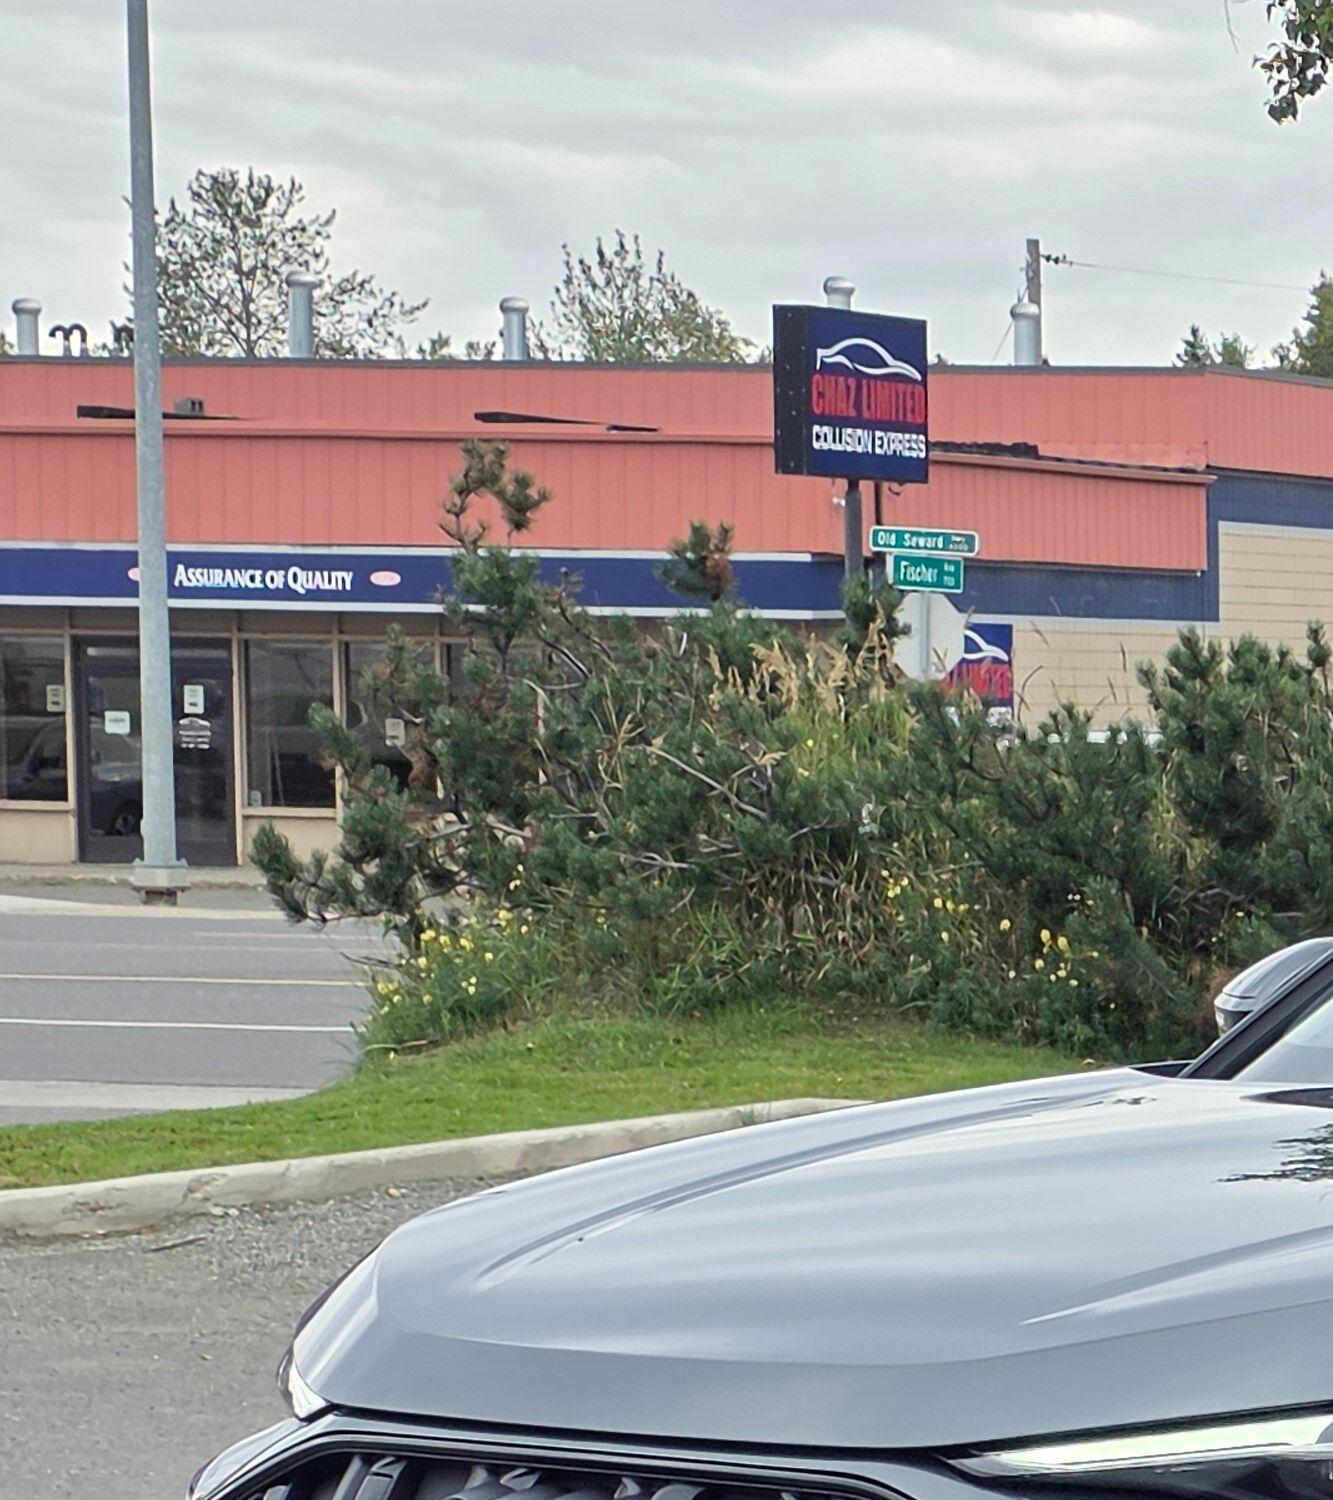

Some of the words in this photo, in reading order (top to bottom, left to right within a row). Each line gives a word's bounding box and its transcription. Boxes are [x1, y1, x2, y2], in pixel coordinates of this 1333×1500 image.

[862, 379, 927, 424] LIMITED
[812, 425, 873, 455] COLLISION
[874, 430, 926, 459] EXPRESS
[877, 531, 896, 546] Old
[903, 533, 944, 549] Seward
[174, 564, 263, 588] ASSURANCE
[265, 570, 285, 589] OF
[287, 566, 353, 594] QUALITY
